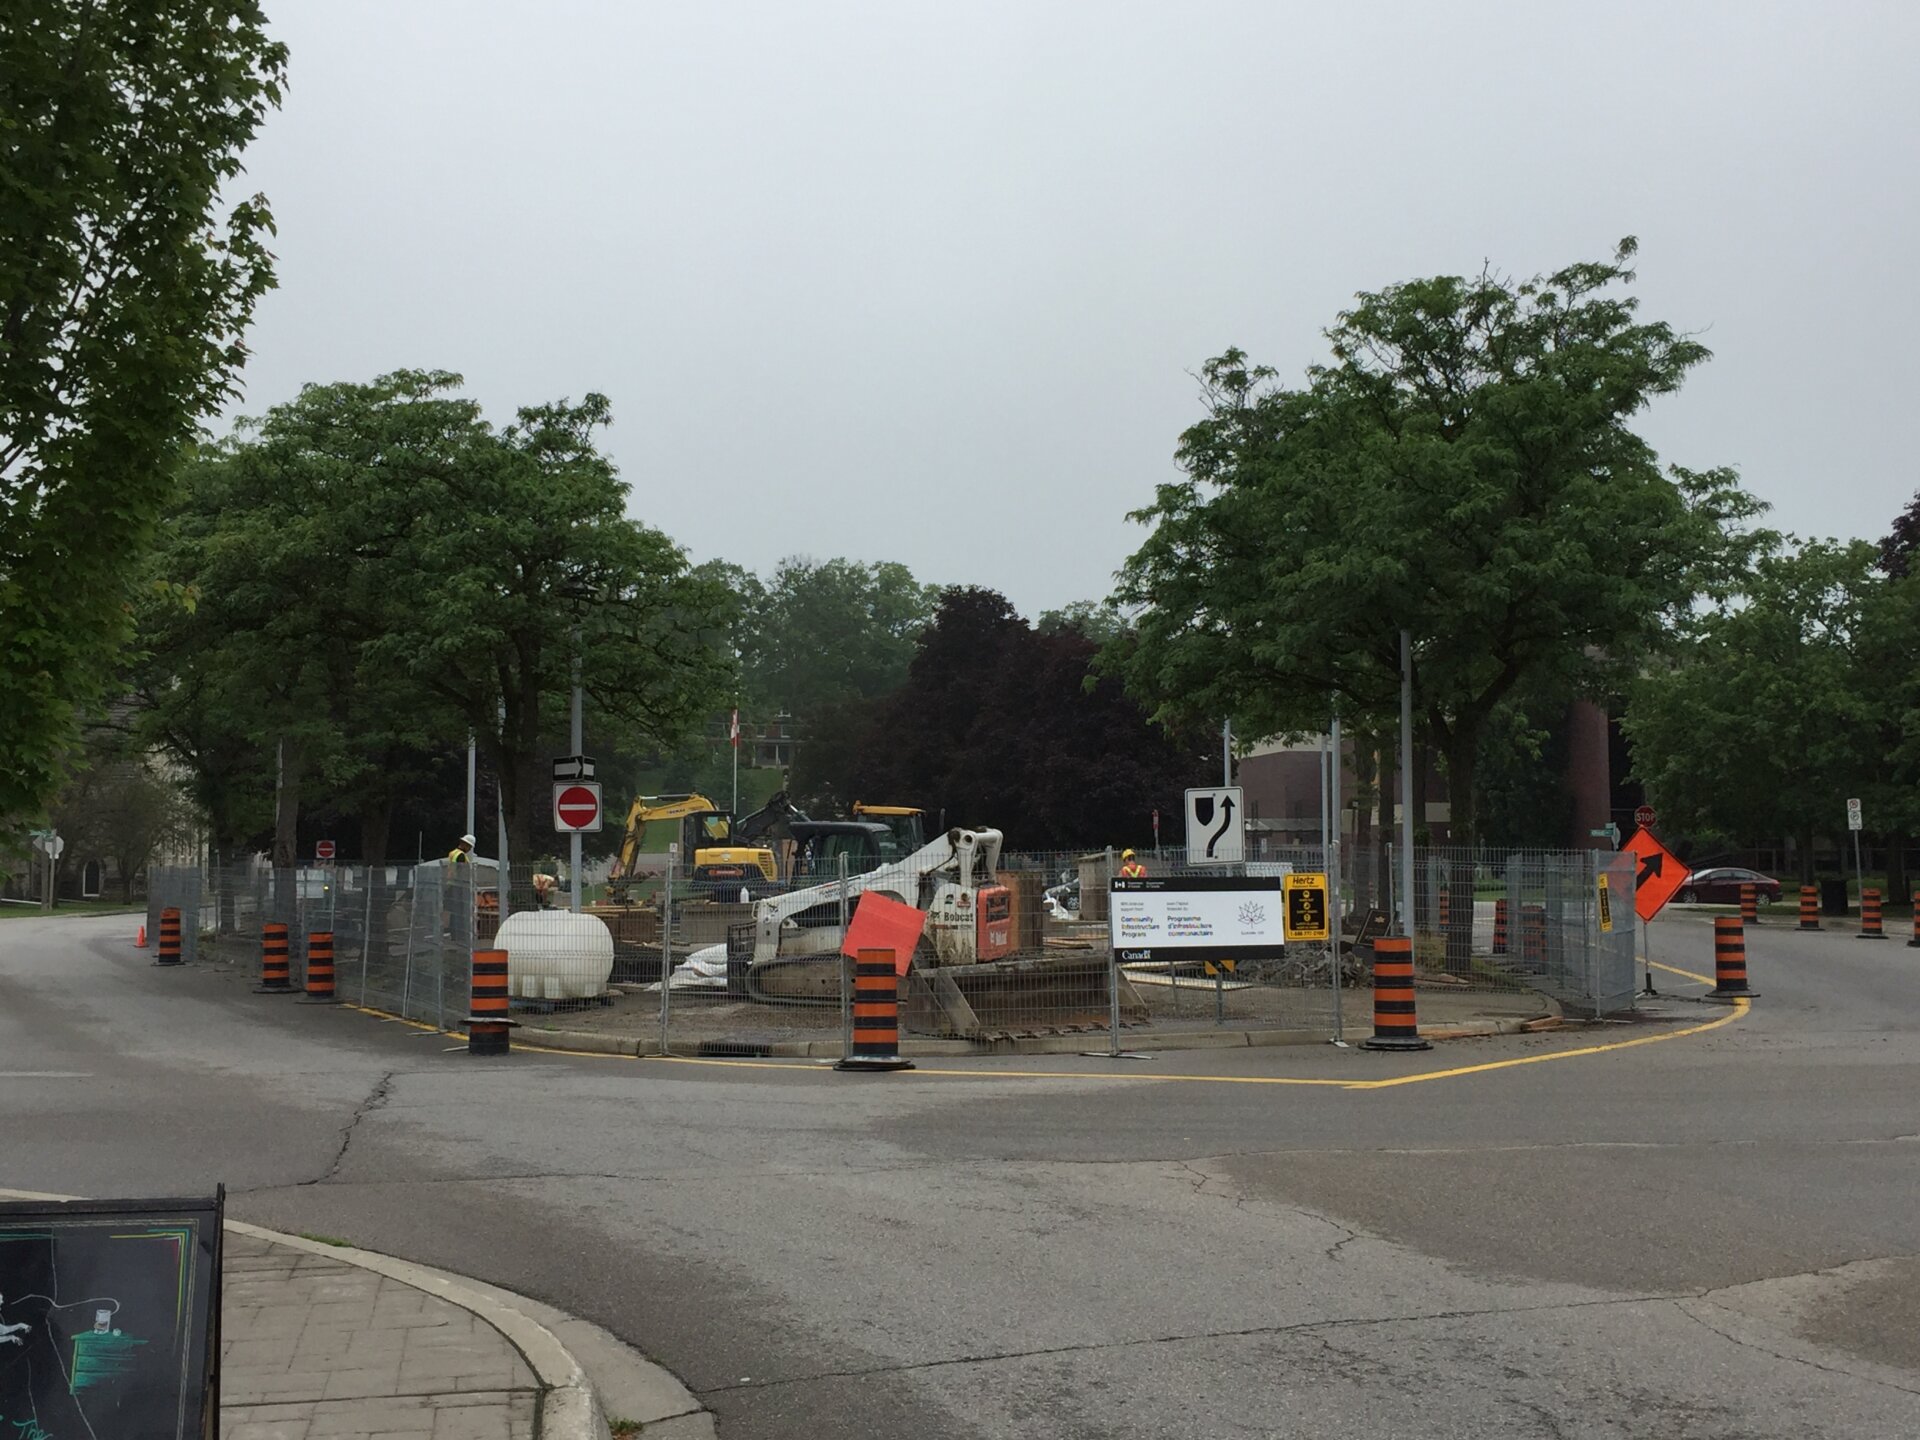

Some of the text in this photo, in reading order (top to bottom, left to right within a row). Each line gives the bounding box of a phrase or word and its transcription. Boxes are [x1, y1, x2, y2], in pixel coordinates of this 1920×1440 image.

[1637, 813, 1655, 821] STOP
[1292, 876, 1315, 884] Hertz
[944, 912, 973, 922] Bobcat
[1121, 949, 1151, 960] Canada
